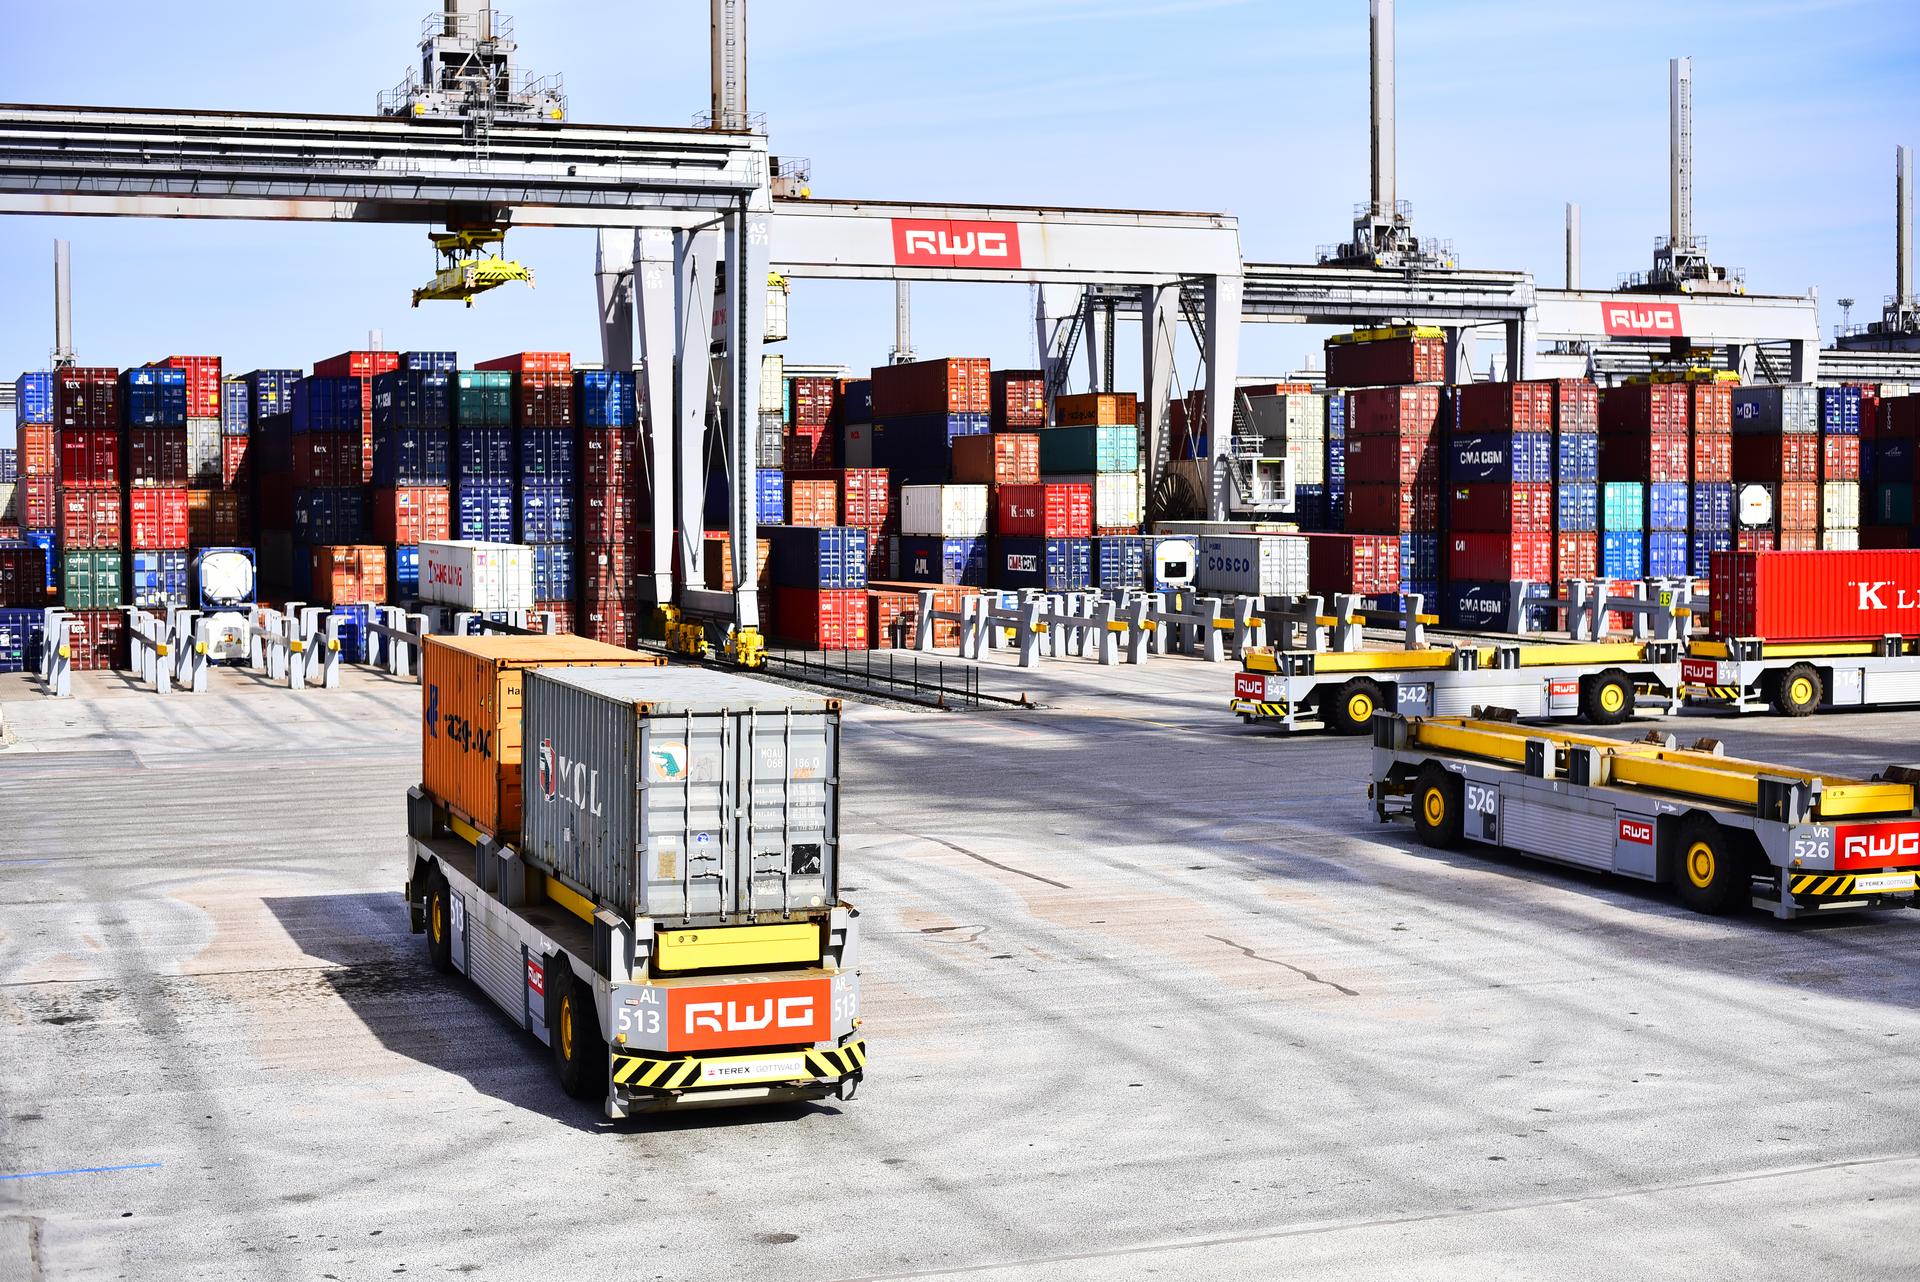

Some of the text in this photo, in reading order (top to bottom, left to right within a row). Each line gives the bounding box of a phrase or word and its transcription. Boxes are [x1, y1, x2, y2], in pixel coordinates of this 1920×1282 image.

[749, 223, 766, 234] AS
[749, 234, 768, 246] 171
[905, 230, 1008, 257] RWG
[1610, 310, 1674, 329] RWG
[65, 380, 81, 389] tex
[1736, 403, 1759, 418] MOL
[313, 444, 327, 453] tex
[588, 440, 602, 450] tex
[1460, 450, 1502, 464] CMA CGM
[69, 502, 85, 511] tex
[590, 497, 603, 508] tex
[914, 558, 929, 575] APL
[1209, 556, 1250, 573] COSCO
[1660, 593, 1670, 605] 15
[1848, 580, 1895, 610] "K"
[1459, 598, 1501, 614] CMA CGM
[528, 614, 542, 623] tex
[590, 613, 604, 622] tex
[71, 623, 86, 634] tex
[1684, 664, 1714, 679] RWG
[1719, 669, 1738, 680] 514
[1834, 670, 1858, 687] 514
[507, 686, 522, 697] Ha
[1237, 679, 1262, 695] RWG
[1267, 685, 1286, 695] 542
[1553, 684, 1577, 693] RWG
[1398, 686, 1426, 703] 542
[766, 758, 783, 768] 068
[795, 758, 810, 768] 186
[1462, 764, 1467, 774] A
[1553, 782, 1558, 792] R
[1468, 786, 1495, 815] 526
[1654, 800, 1660, 811] V
[1622, 824, 1650, 841] RWG
[1812, 826, 1829, 839] VR
[1794, 840, 1830, 859] 526
[1844, 832, 1920, 859] RWG
[450, 893, 464, 932] 513
[528, 965, 543, 989] RWG
[640, 989, 660, 1005] AL
[834, 993, 856, 1022] 513
[618, 1008, 660, 1034] 513
[685, 996, 814, 1034] RWG
[718, 1063, 801, 1075] TEREX GOTTWALD
